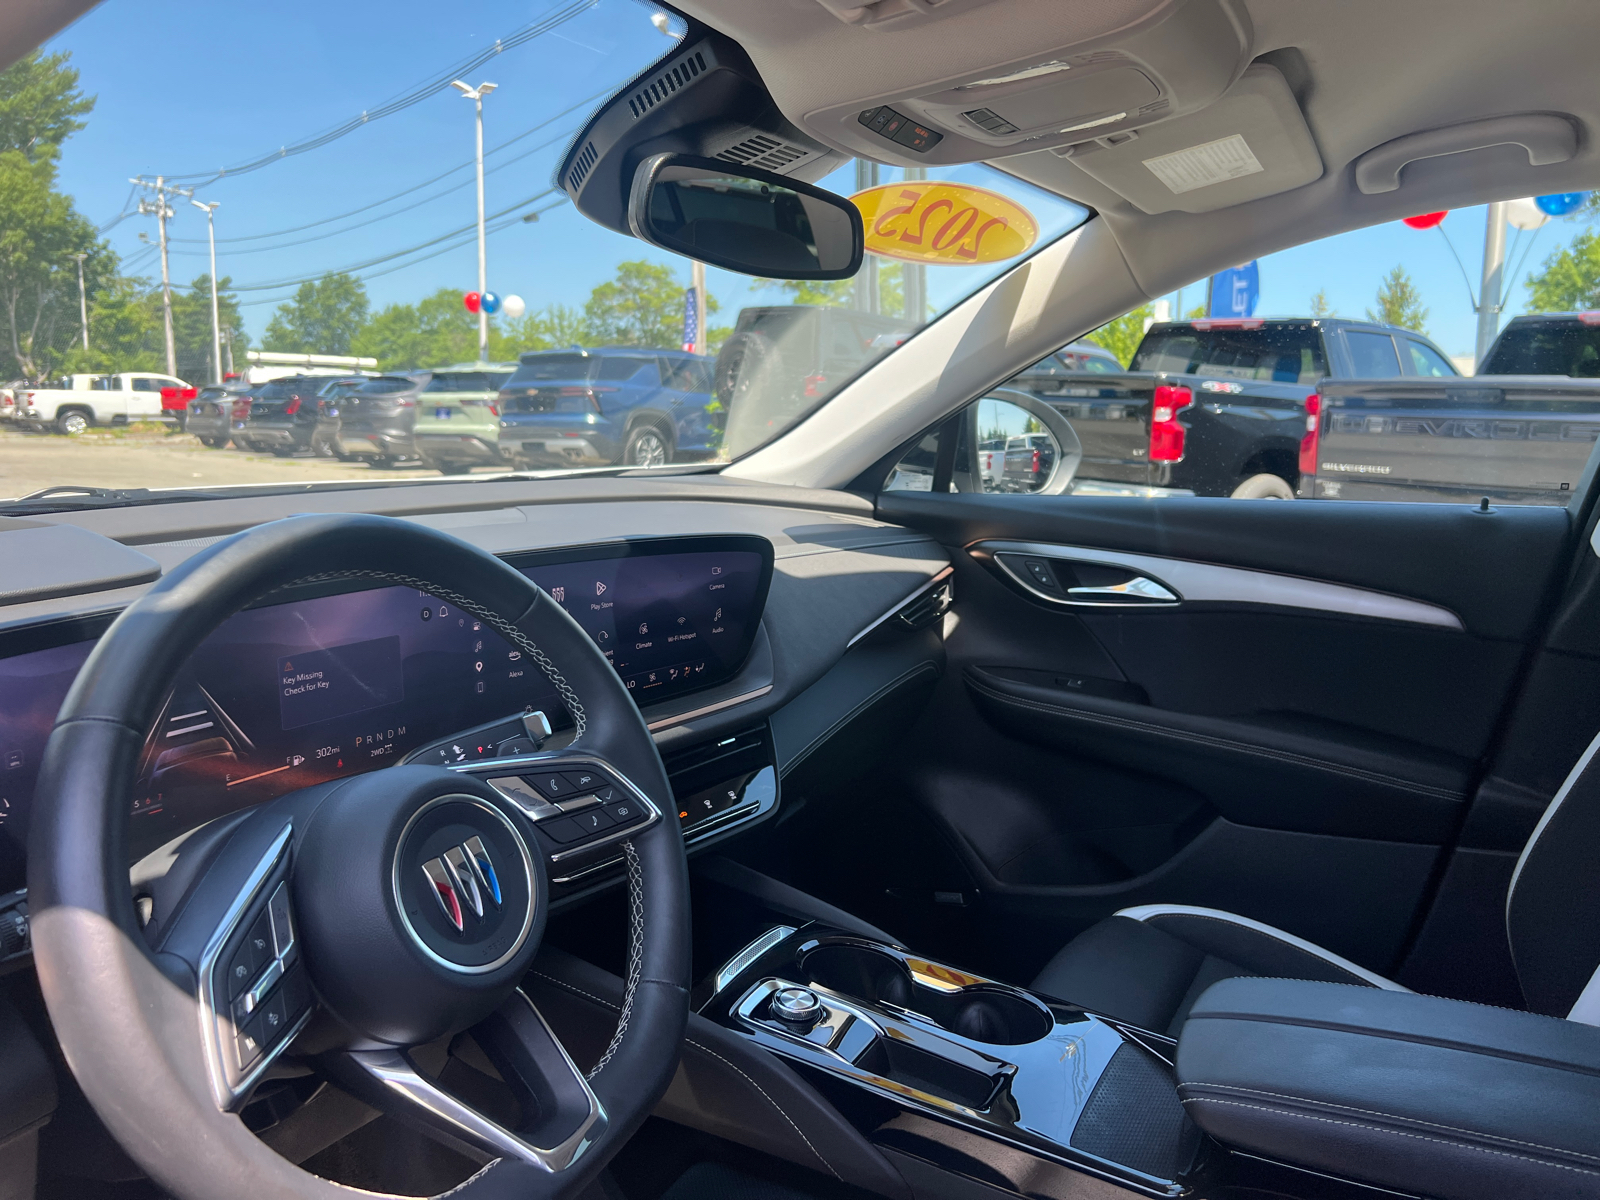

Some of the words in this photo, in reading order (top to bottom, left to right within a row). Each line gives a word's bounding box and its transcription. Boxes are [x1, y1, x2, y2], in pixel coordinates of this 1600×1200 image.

[1231, 274, 1249, 318] ET
[1331, 413, 1600, 443] CHEVROLE
[590, 603, 601, 611] Play
[600, 601, 614, 609] Store
[712, 626, 724, 634] Audio
[667, 634, 679, 643] Wi-Fi
[679, 632, 697, 641] Hotspot
[635, 641, 653, 650] Climate
[283, 676, 296, 686] Key
[296, 671, 323, 682] Missing
[508, 670, 524, 678] Alexa
[284, 685, 306, 697] Check
[306, 683, 317, 691] for
[317, 681, 330, 689] Key
[626, 680, 636, 689] LO
[355, 736, 363, 748] P
[366, 735, 374, 745] R
[376, 732, 384, 742] N
[387, 729, 395, 739] D
[398, 726, 406, 736] M
[370, 747, 385, 757] 2WD
